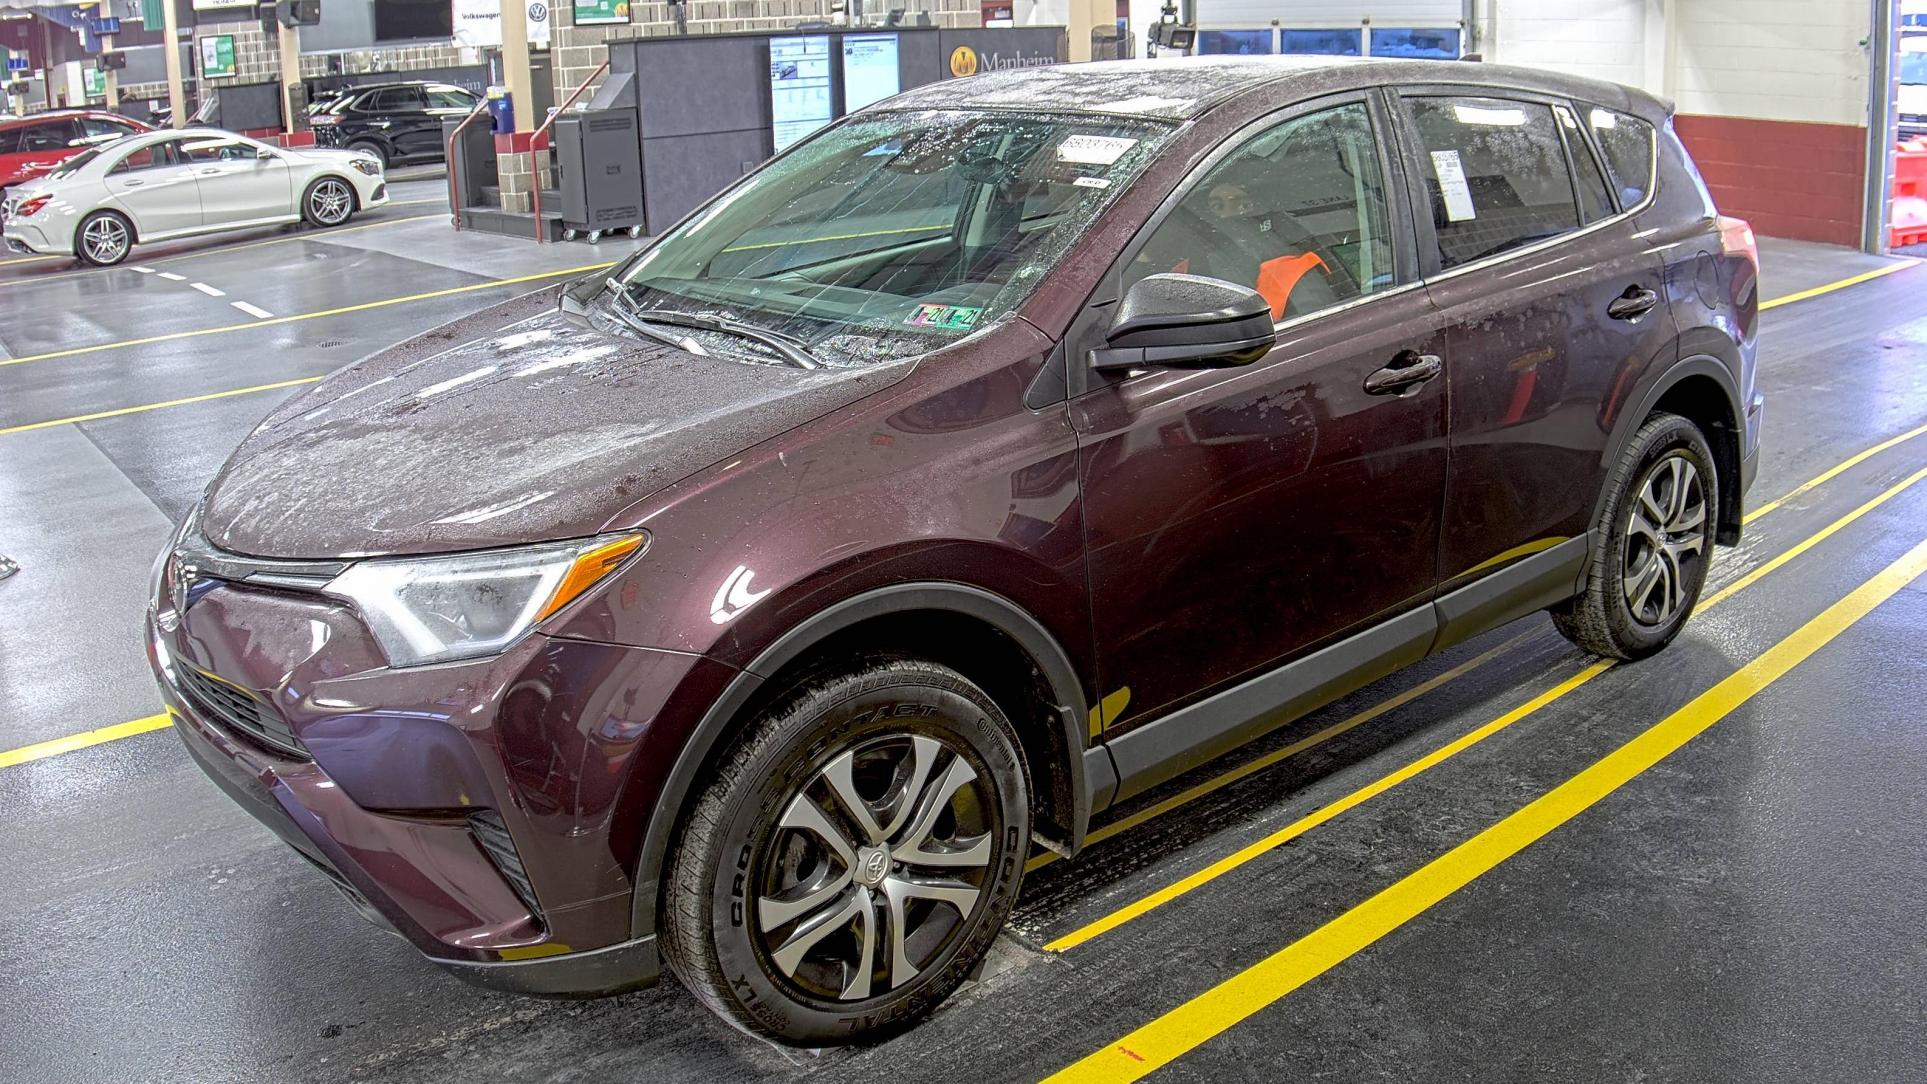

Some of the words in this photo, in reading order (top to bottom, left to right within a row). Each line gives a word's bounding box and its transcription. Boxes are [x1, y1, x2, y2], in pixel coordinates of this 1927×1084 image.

[980, 50, 1054, 73] Manheim
[976, 717, 1013, 765] Continental
[837, 825, 1019, 1033] CONTINENTAL
[732, 974, 758, 1005] LX
